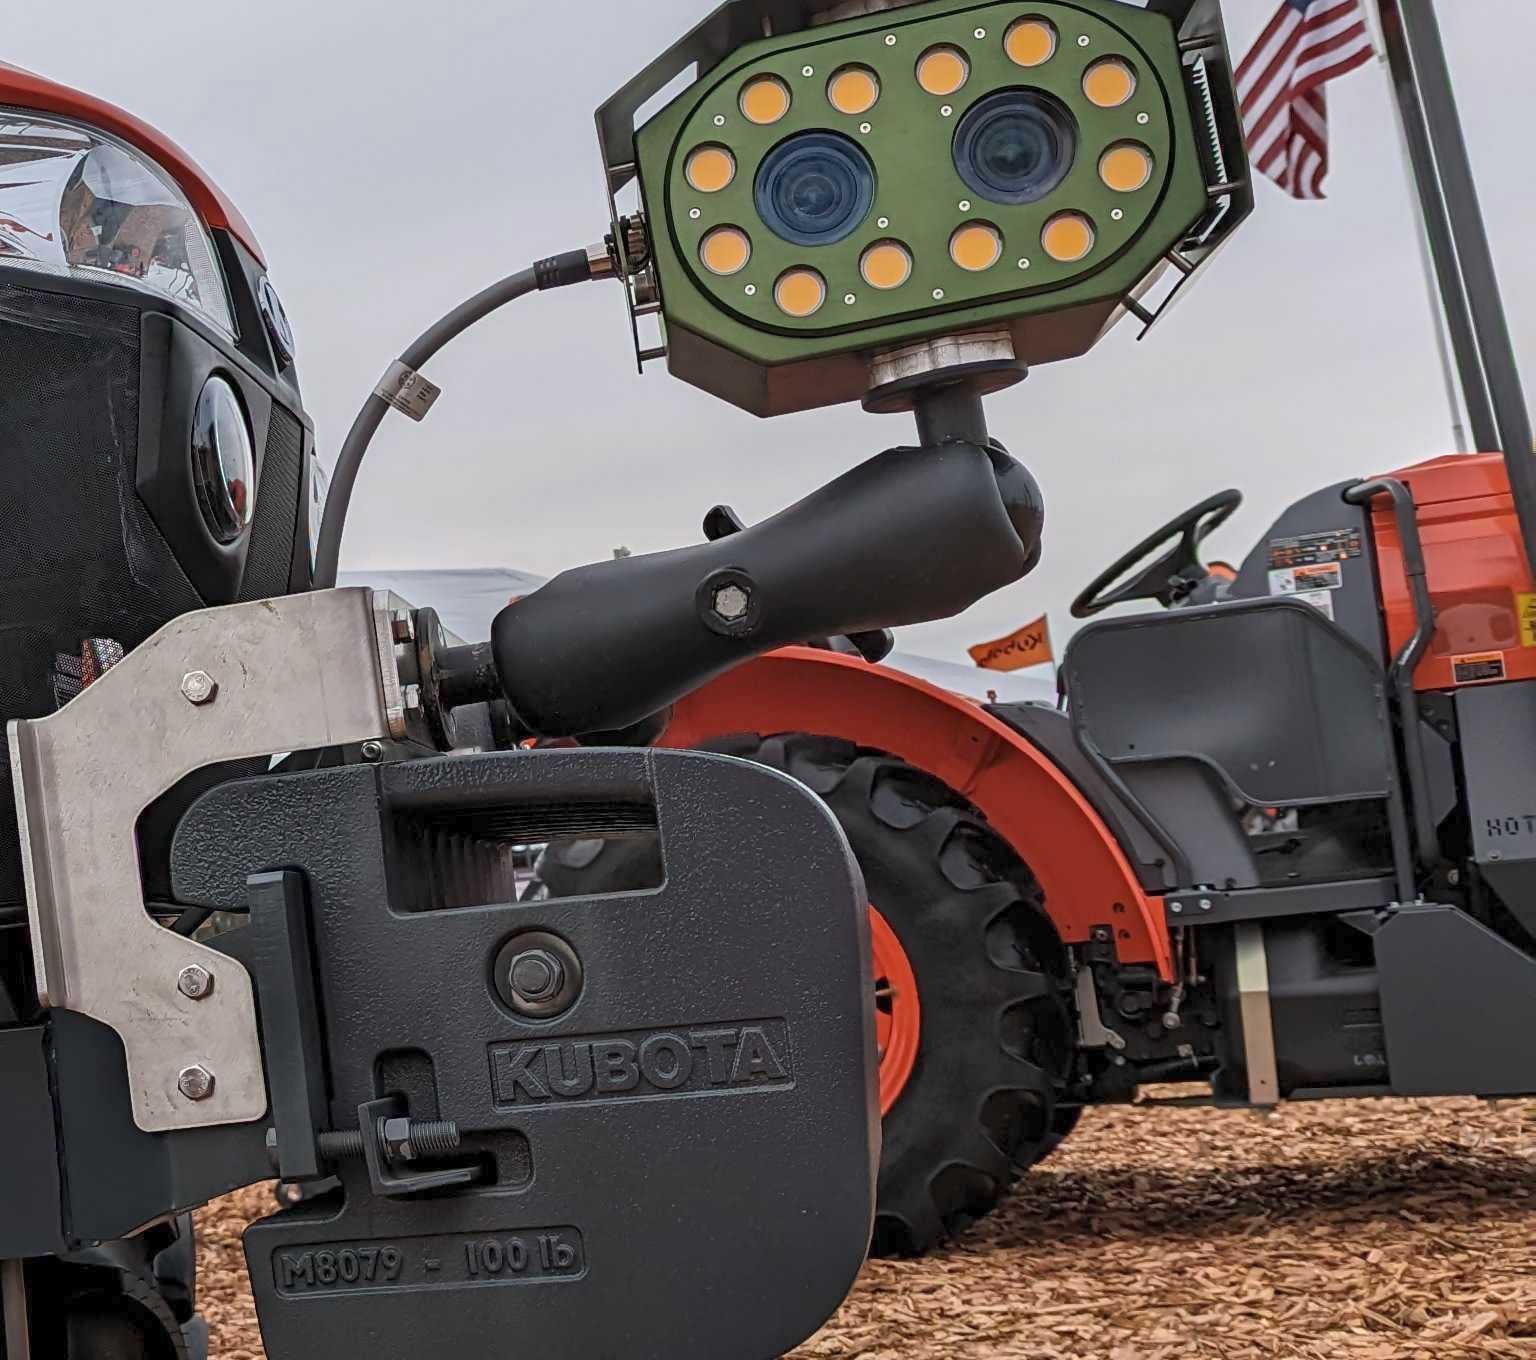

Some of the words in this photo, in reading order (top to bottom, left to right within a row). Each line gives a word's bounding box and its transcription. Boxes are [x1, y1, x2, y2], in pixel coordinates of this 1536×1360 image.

[494, 1026, 789, 1102] KUBOTA
[280, 1245, 402, 1287] M8079
[465, 1239, 529, 1275] 100
